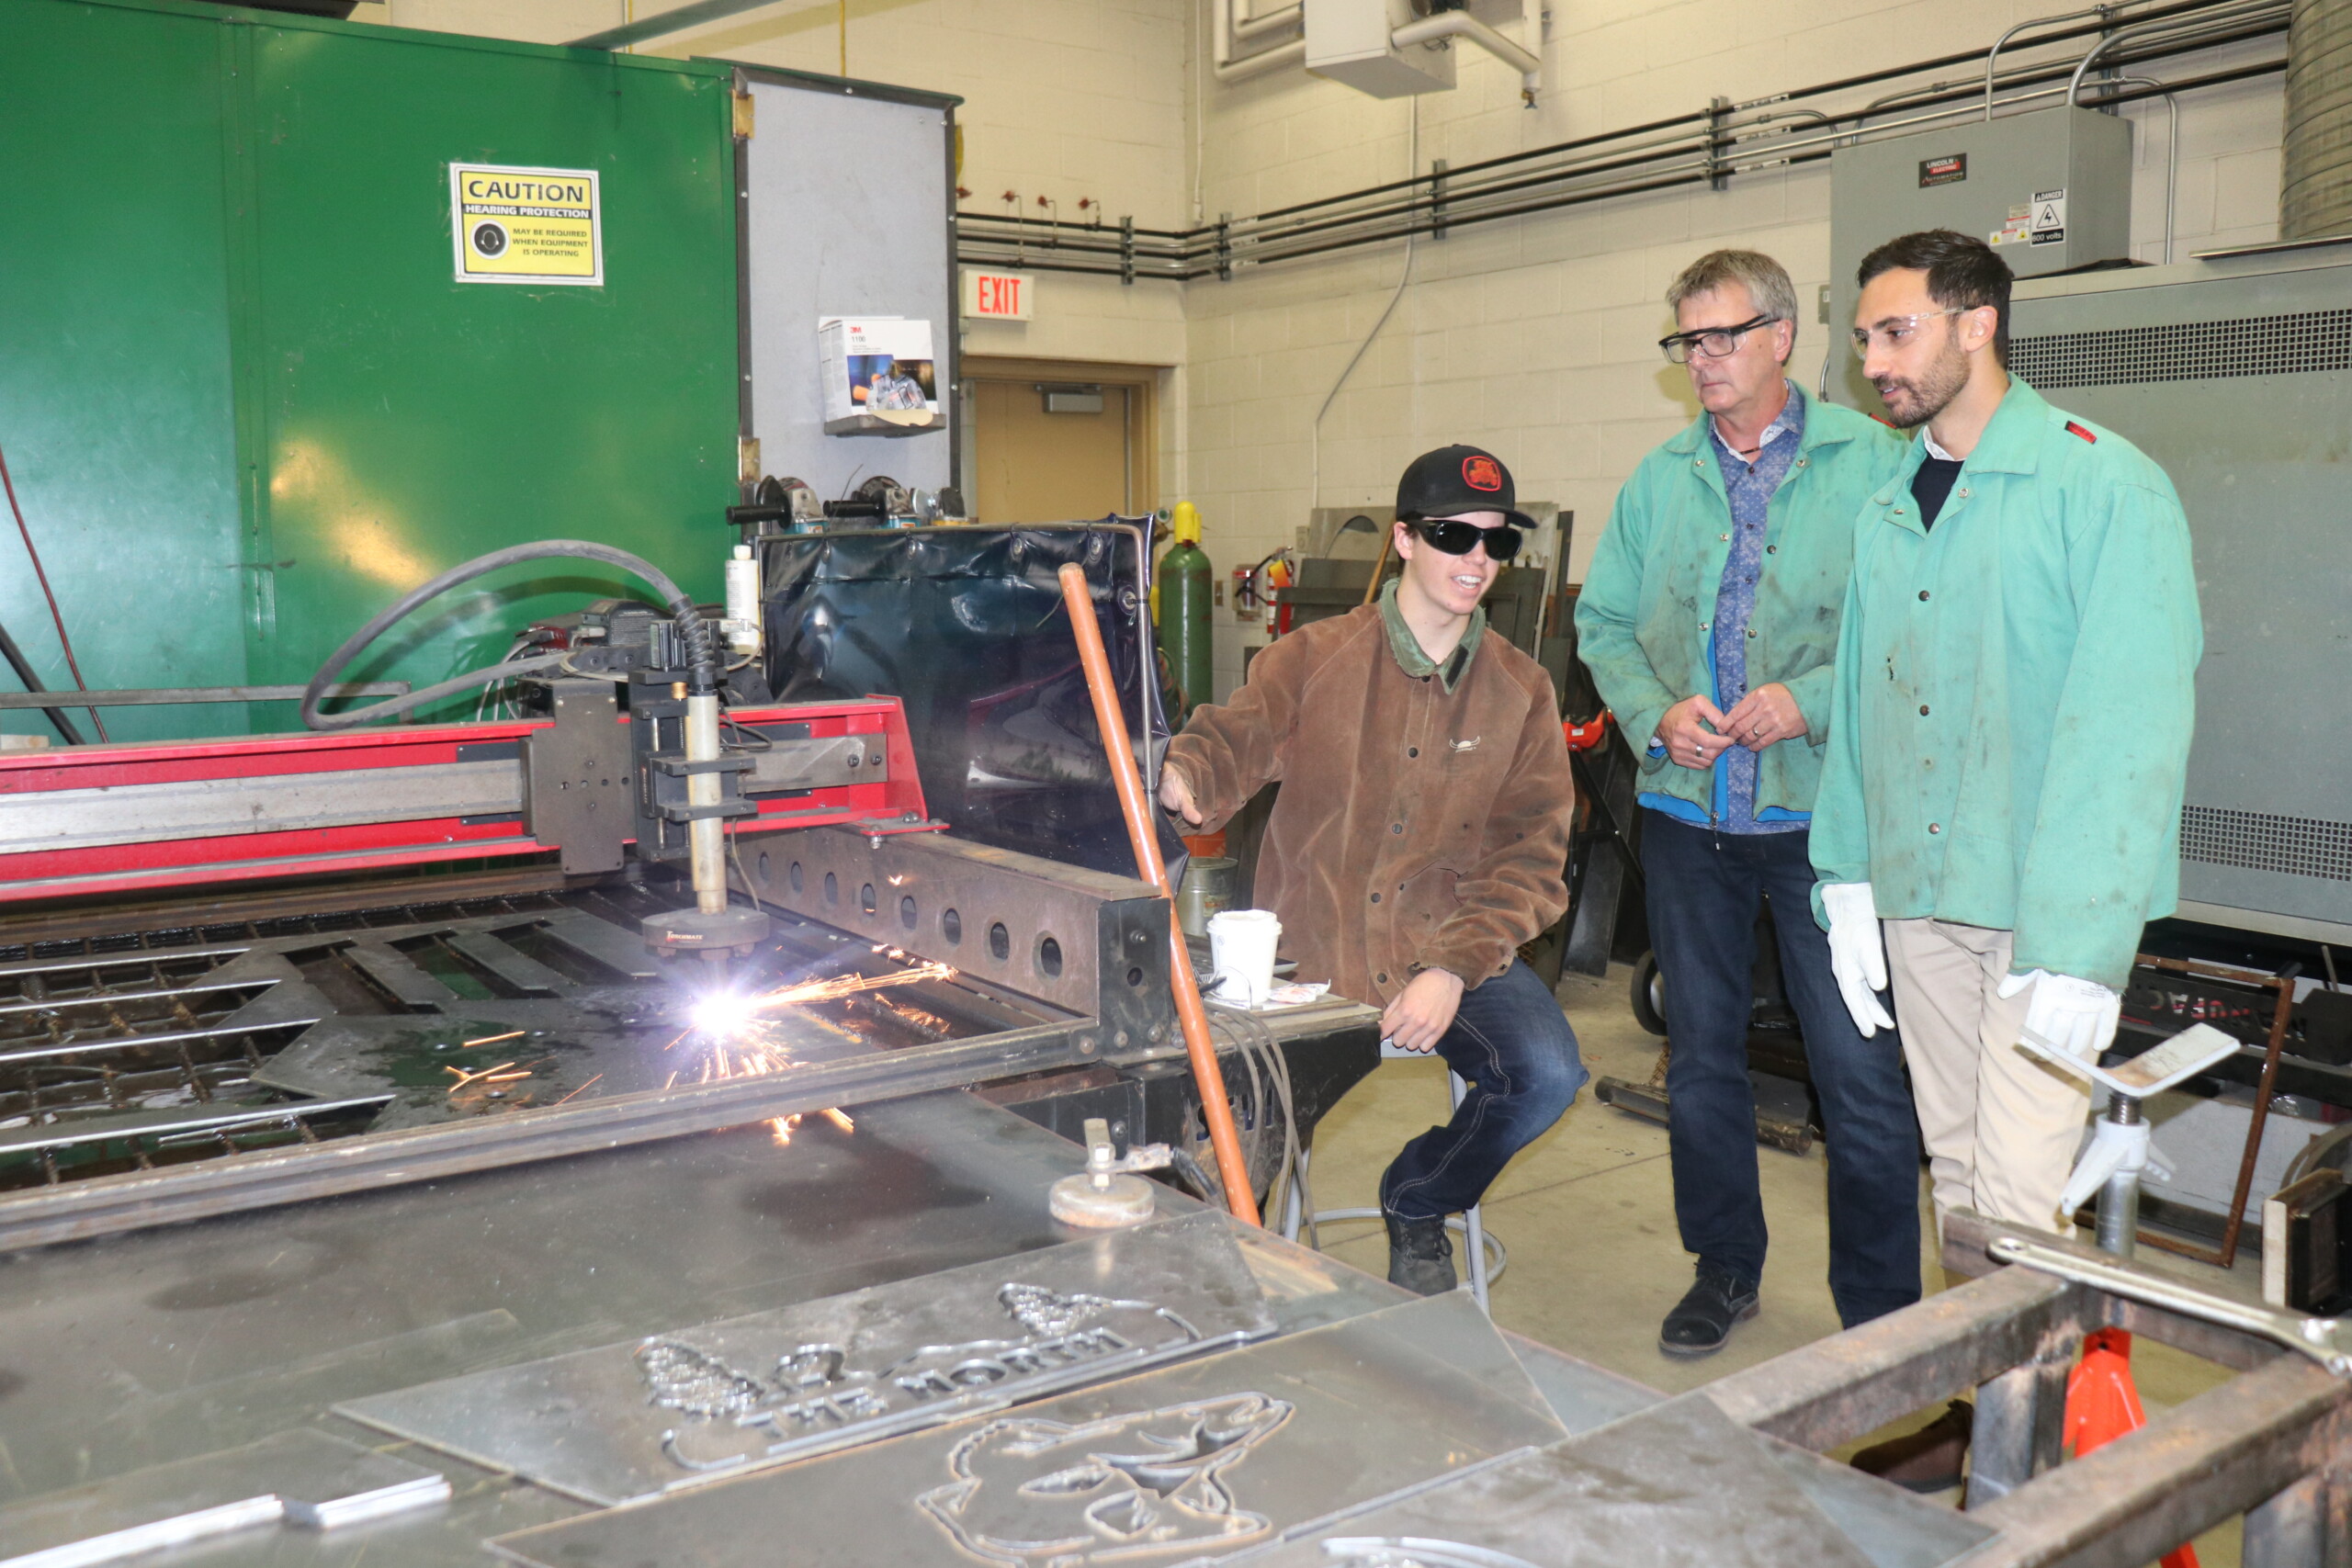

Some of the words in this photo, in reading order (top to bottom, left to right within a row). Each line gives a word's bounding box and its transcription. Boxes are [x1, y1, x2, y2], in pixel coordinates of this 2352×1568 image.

[1927, 158, 1954, 169] LINCOLN
[1932, 164, 1957, 174] ELECTRIC
[469, 180, 583, 203] CAUTION
[2041, 190, 2064, 201] DANGER
[466, 204, 517, 216] HEARING
[519, 207, 590, 219] PROTECTION
[546, 230, 587, 238] REQUIRED
[2031, 233, 2045, 243] 600
[532, 249, 579, 257] OPERATING
[978, 276, 1022, 315] EXIT
